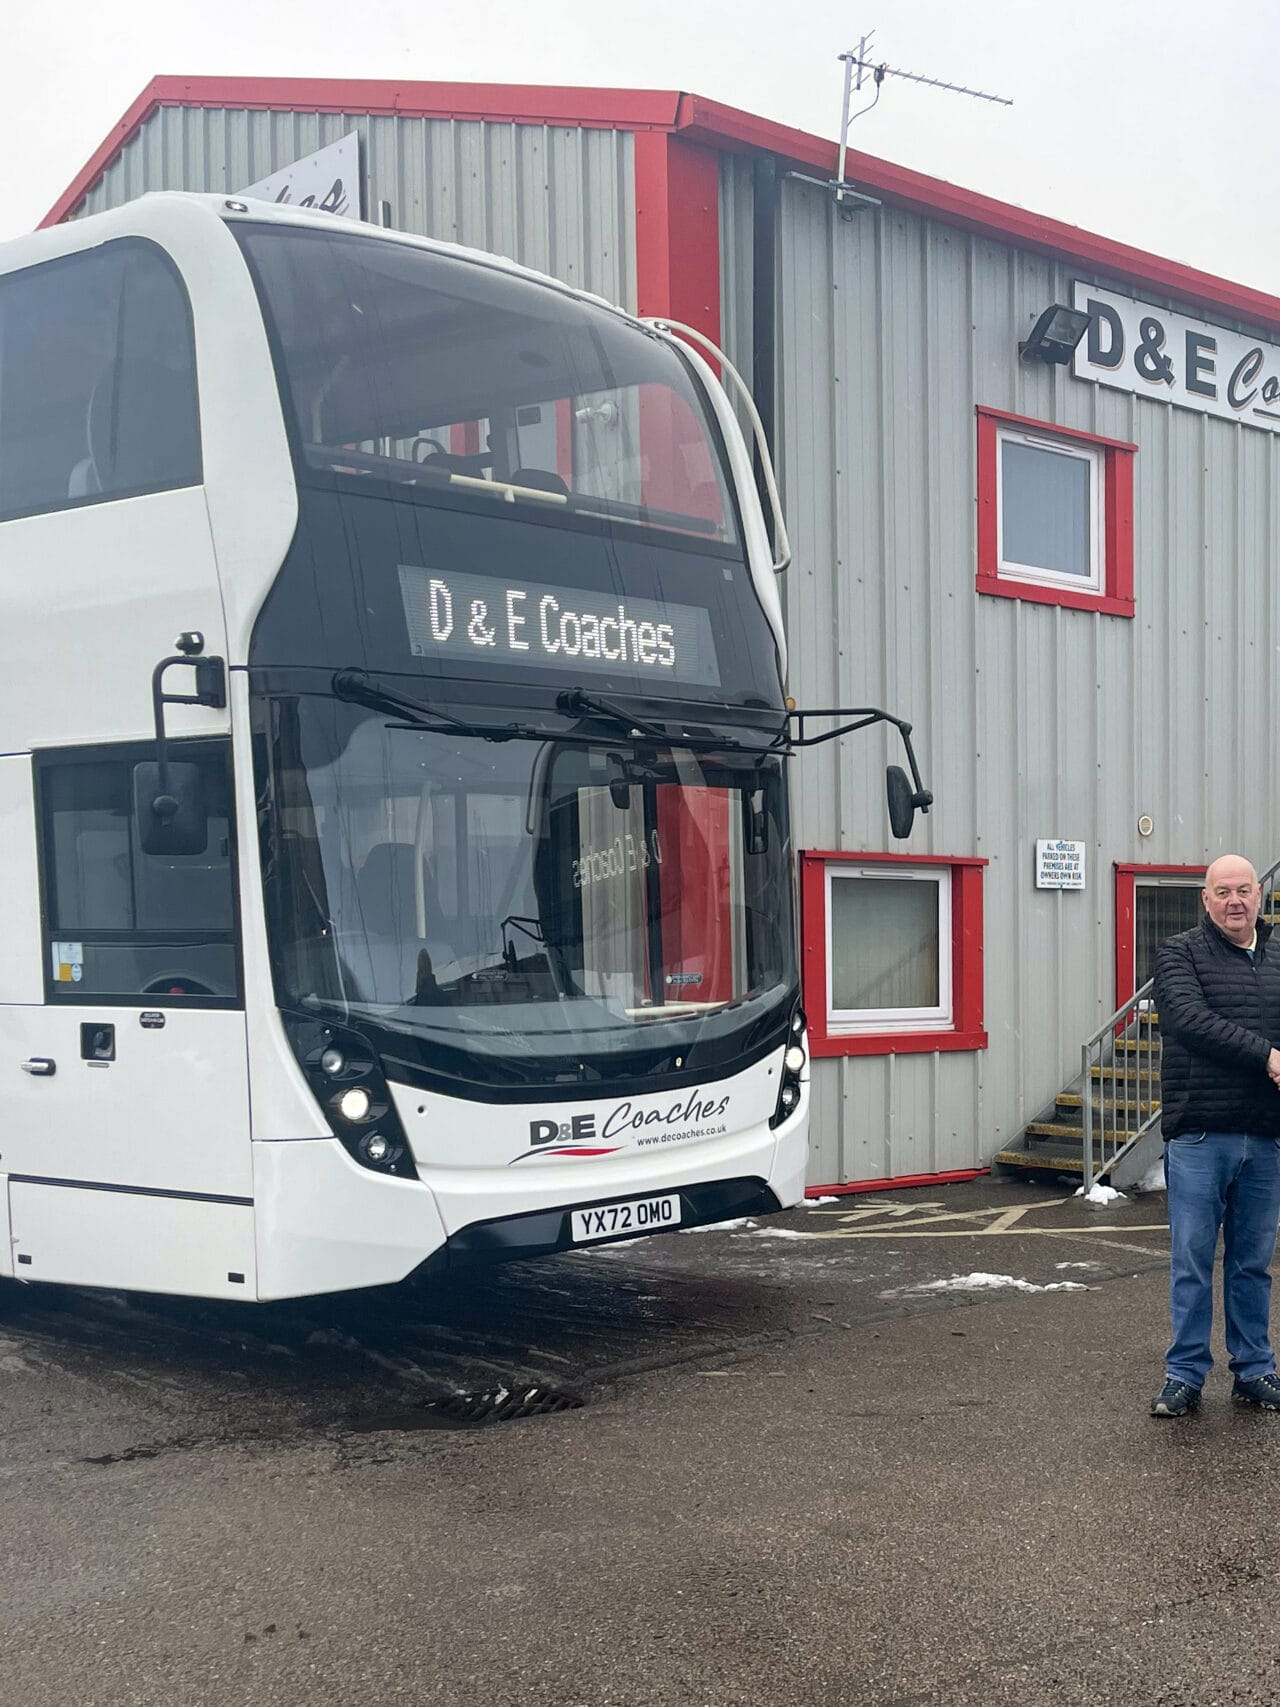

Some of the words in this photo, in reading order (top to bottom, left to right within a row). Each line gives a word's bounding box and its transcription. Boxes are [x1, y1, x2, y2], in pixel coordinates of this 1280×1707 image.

[429, 579, 454, 642] D
[467, 600, 497, 647] &
[506, 590, 530, 651] E
[539, 595, 675, 667] Coaches
[530, 1114, 596, 1146] D&E
[602, 1089, 730, 1139] Coaches
[637, 1125, 727, 1147] www.decoaches.co.uk
[581, 1207, 632, 1235] YX72
[637, 1200, 672, 1225] OMO
